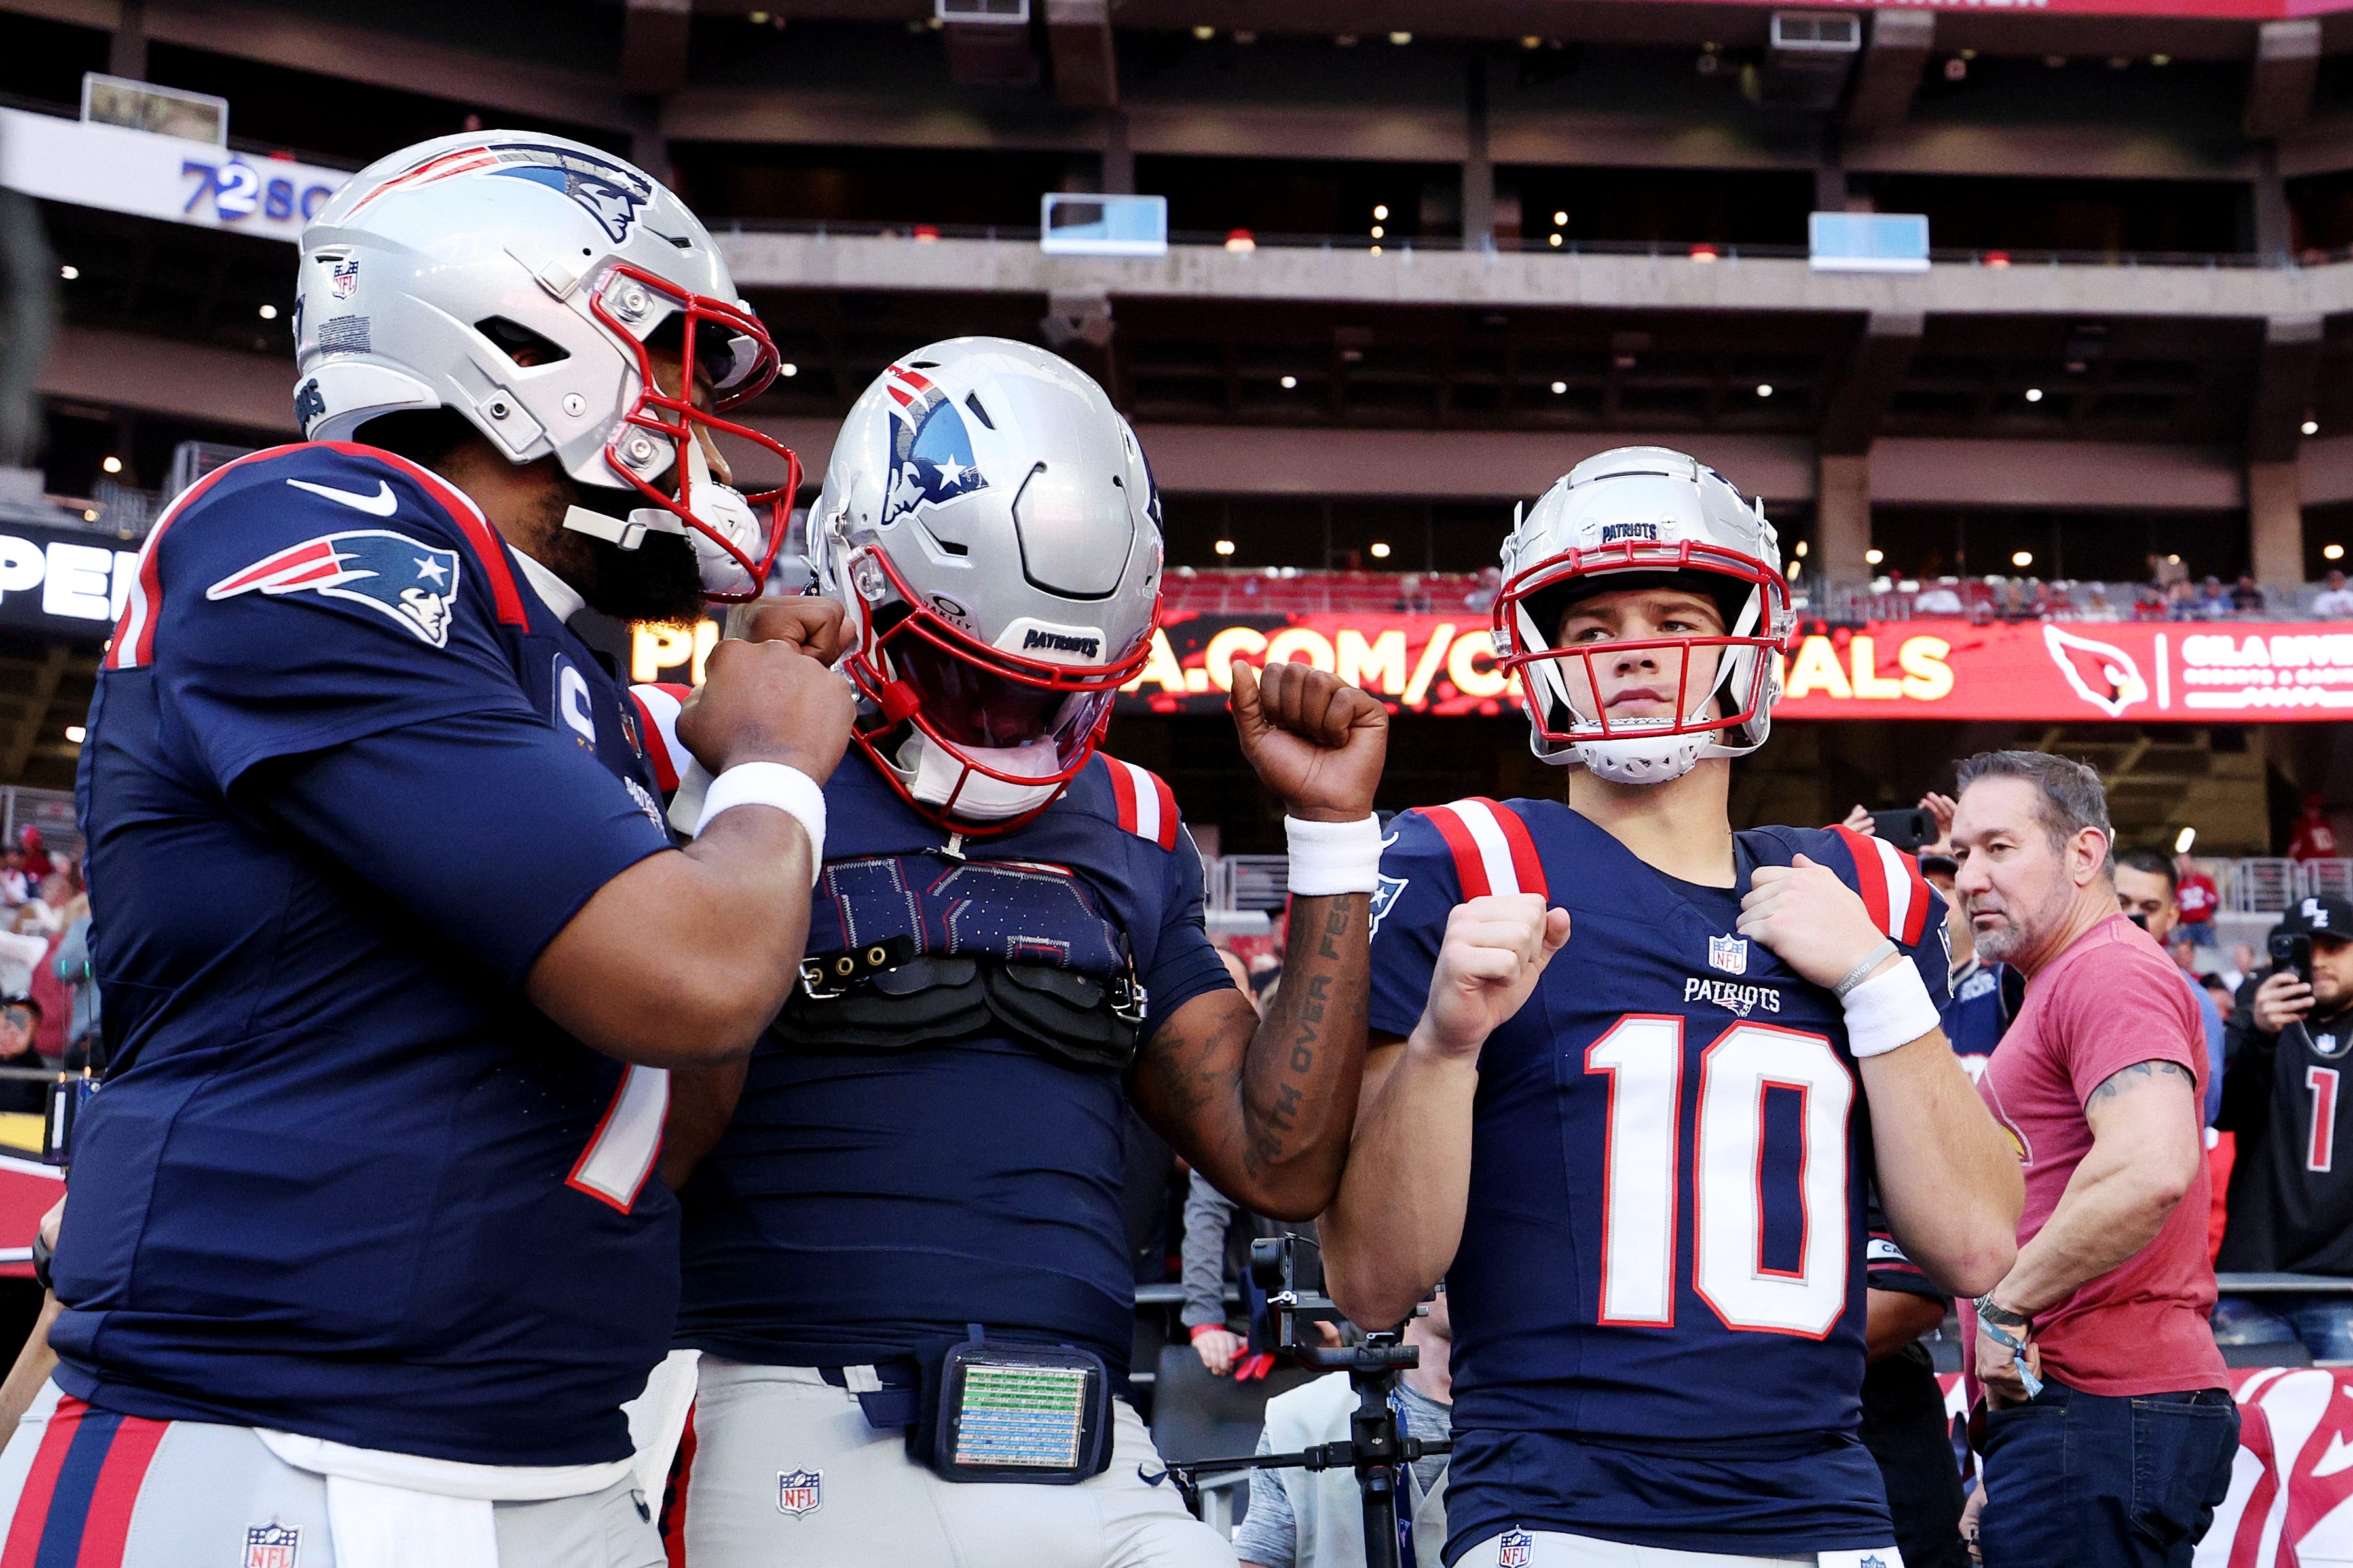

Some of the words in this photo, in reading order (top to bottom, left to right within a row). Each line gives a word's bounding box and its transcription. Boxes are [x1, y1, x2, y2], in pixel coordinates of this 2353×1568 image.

[1603, 522, 1657, 544] PATRIOTS
[1023, 629, 1100, 658] PATRIOTS
[1716, 952, 1740, 970] NFL
[1838, 962, 1871, 994] MayeWay
[1684, 977, 1781, 1013] PATRIOTS
[1290, 974, 1333, 1074] OVER
[2305, 1065, 2340, 1173] 1
[1584, 1013, 1855, 1341] 10
[785, 1488, 816, 1509] NFL
[250, 1546, 291, 1568] NFL
[1502, 1548, 1527, 1565] NFL
